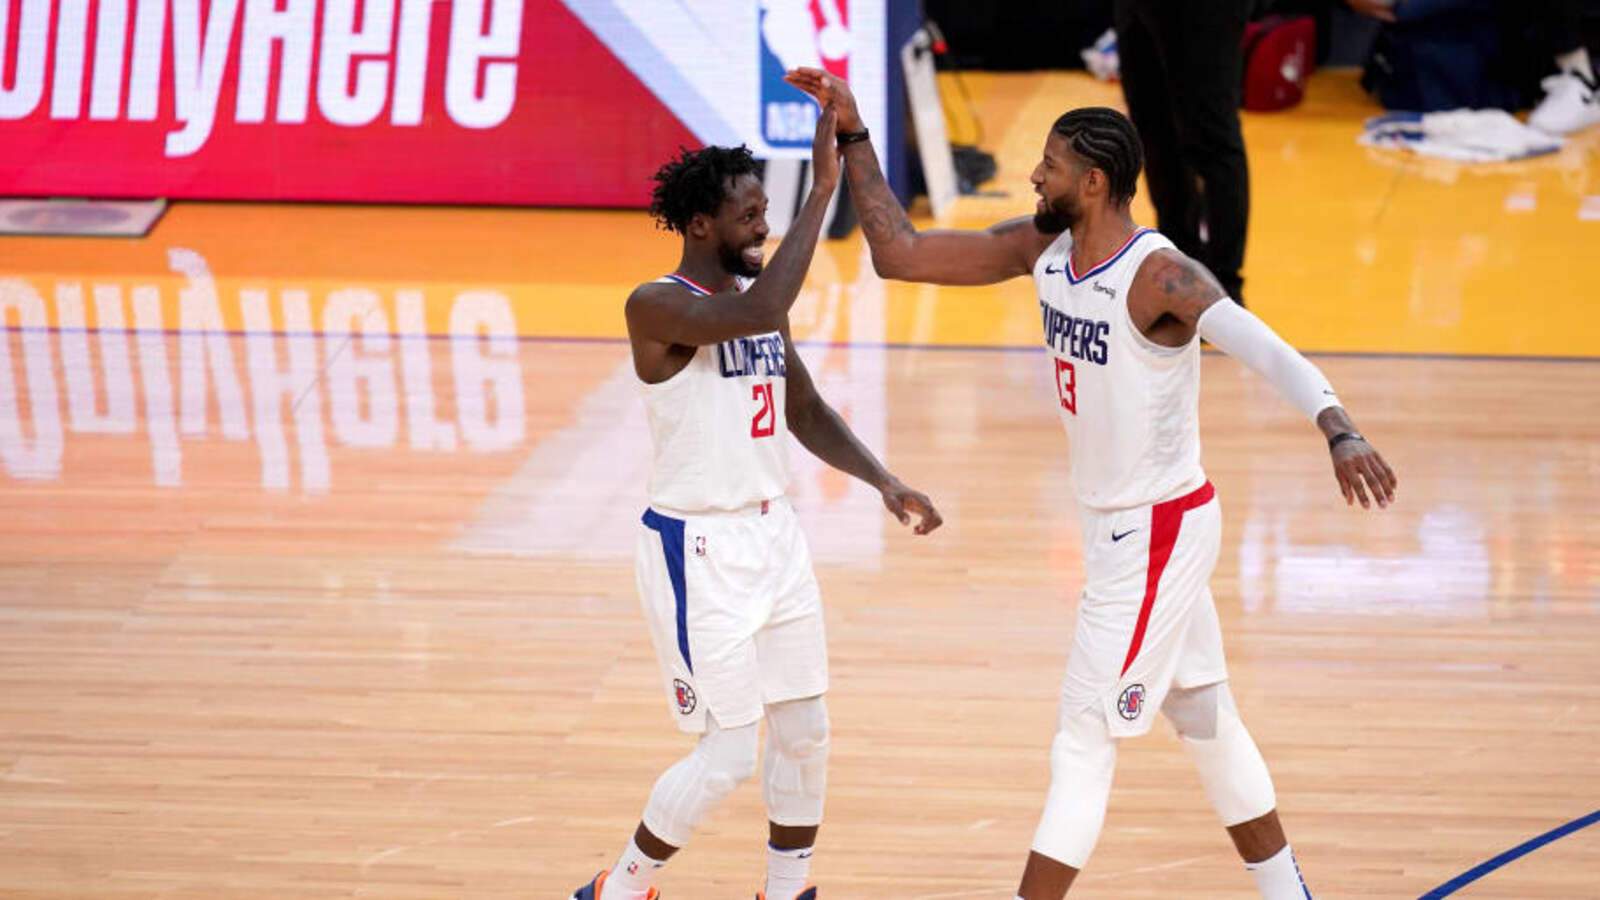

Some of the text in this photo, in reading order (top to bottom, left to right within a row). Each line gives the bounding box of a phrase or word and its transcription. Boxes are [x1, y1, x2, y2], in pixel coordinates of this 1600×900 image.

[766, 101, 817, 141] NBA
[1040, 300, 1110, 366] LIPPERS
[751, 381, 776, 438] 21
[1054, 356, 1077, 415] 13
